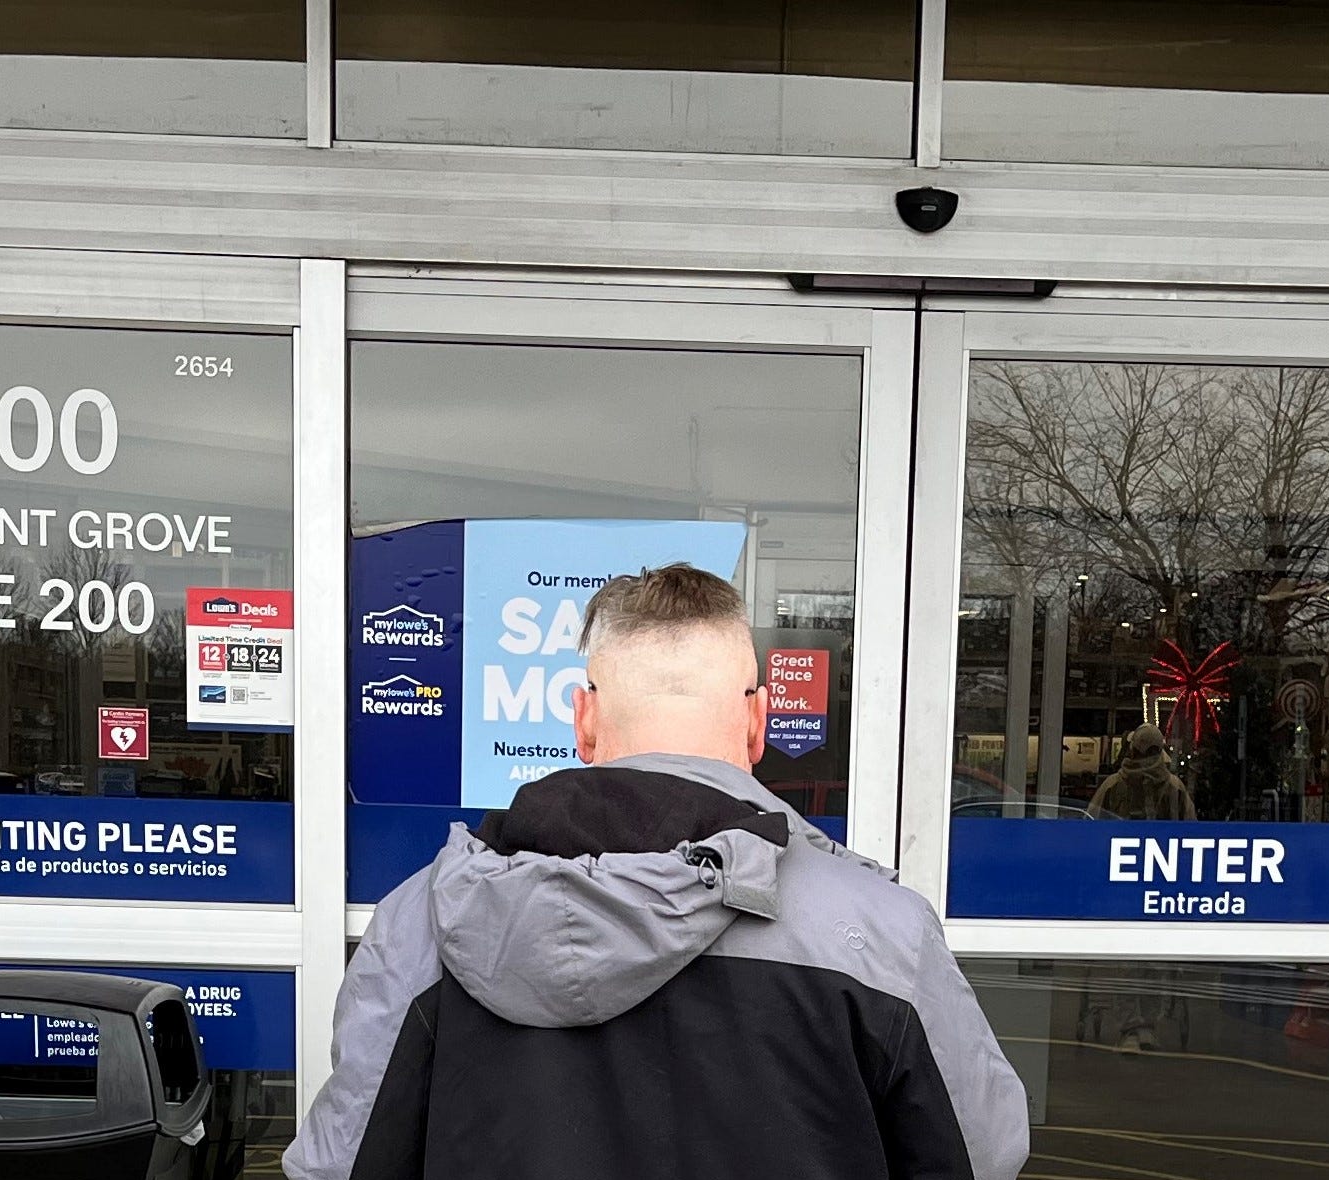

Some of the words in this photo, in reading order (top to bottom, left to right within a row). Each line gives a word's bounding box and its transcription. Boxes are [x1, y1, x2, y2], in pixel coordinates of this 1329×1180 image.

[173, 355, 234, 378] 2654
[68, 510, 232, 555] GROVE
[527, 571, 560, 587] Our
[38, 578, 156, 635] 200
[241, 602, 278, 616] Deals
[374, 618, 429, 631] mylowe's
[362, 627, 444, 646] Rewards
[201, 645, 221, 661] 12
[230, 646, 250, 662] 18
[257, 647, 280, 664] 24
[770, 653, 814, 668] Great
[771, 667, 813, 681] Place
[416, 686, 442, 698] PRO
[769, 682, 787, 695] To
[362, 696, 444, 716] Rewards
[770, 718, 821, 730] Certified
[494, 741, 568, 758] Nuestros
[97, 821, 237, 855] PLEASE
[15, 857, 37, 873] de
[41, 857, 129, 877] productos
[133, 862, 144, 875] o
[148, 859, 228, 877] servicios
[1108, 837, 1285, 884] ENTER
[1143, 891, 1246, 915] Entrada
[185, 986, 196, 1000] A
[199, 986, 242, 1000] DRUG
[47, 1046, 86, 1058] prueba
